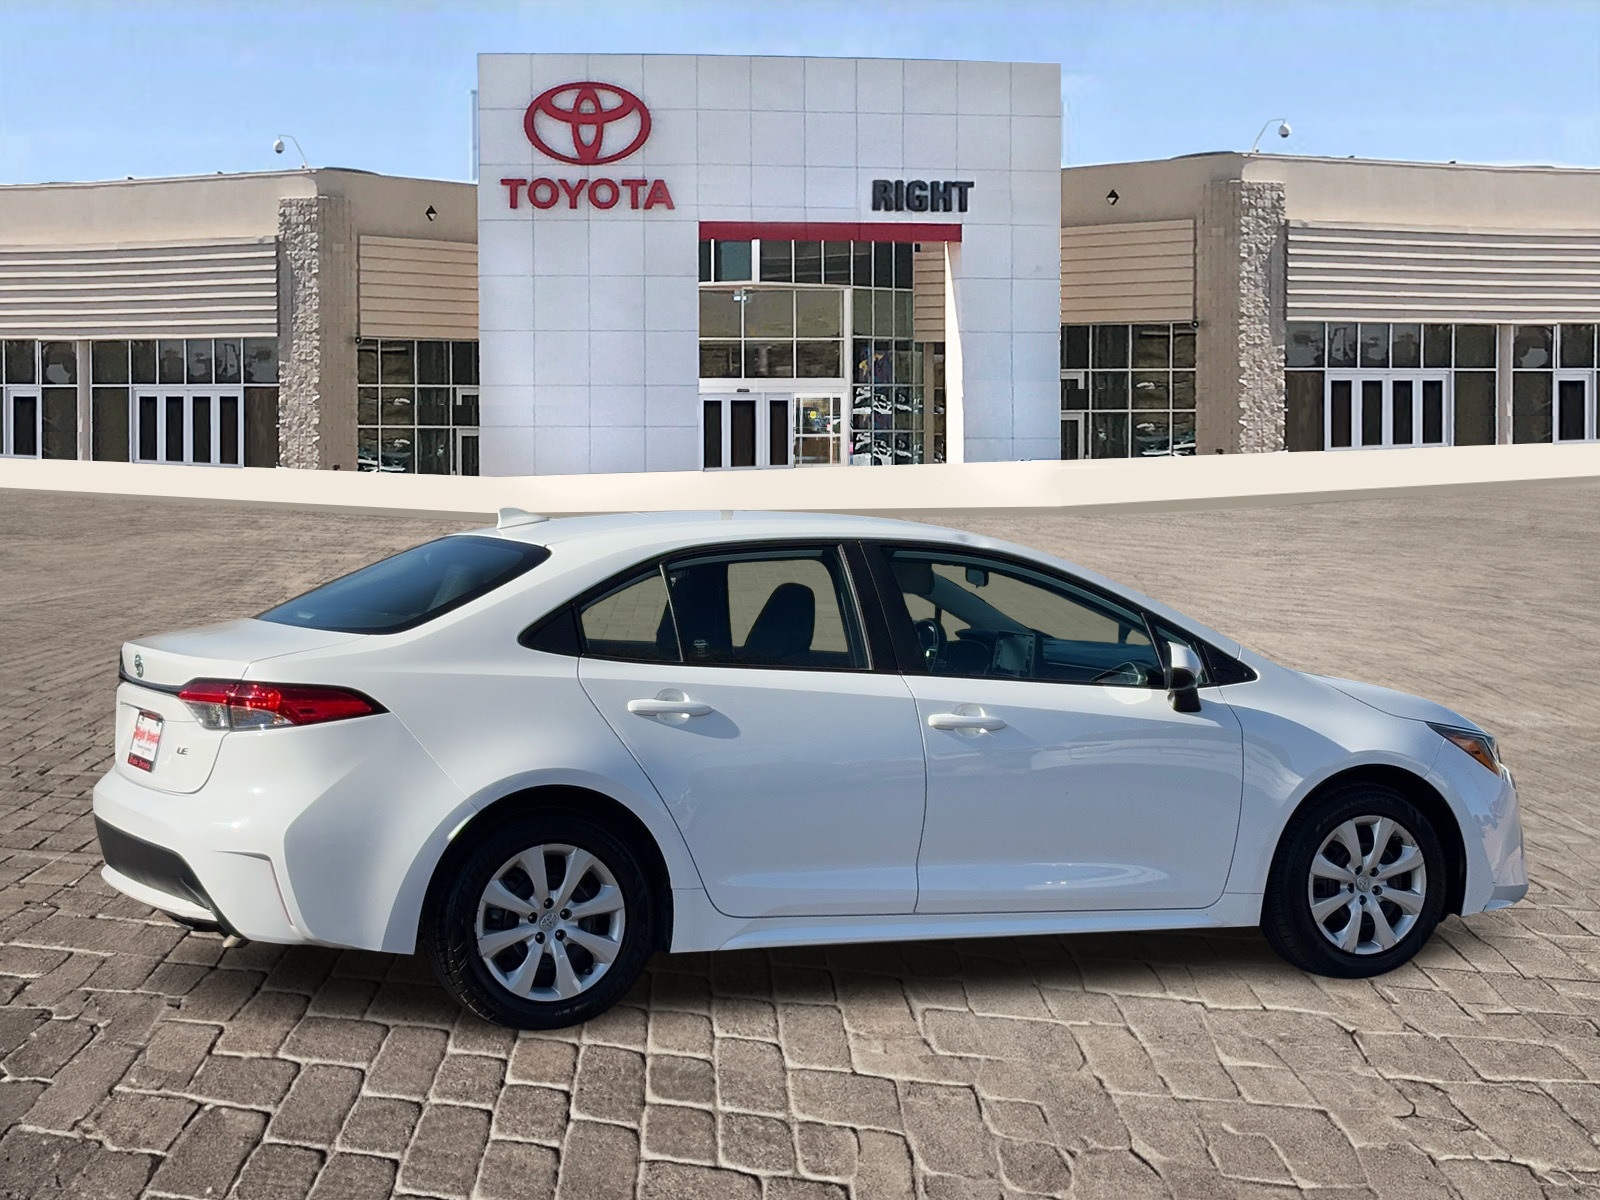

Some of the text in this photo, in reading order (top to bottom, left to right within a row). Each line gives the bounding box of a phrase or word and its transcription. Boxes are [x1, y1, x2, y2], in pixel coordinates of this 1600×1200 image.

[500, 178, 675, 209] TOYOTA
[872, 180, 974, 212] RIGHT
[176, 747, 189, 756] LE
